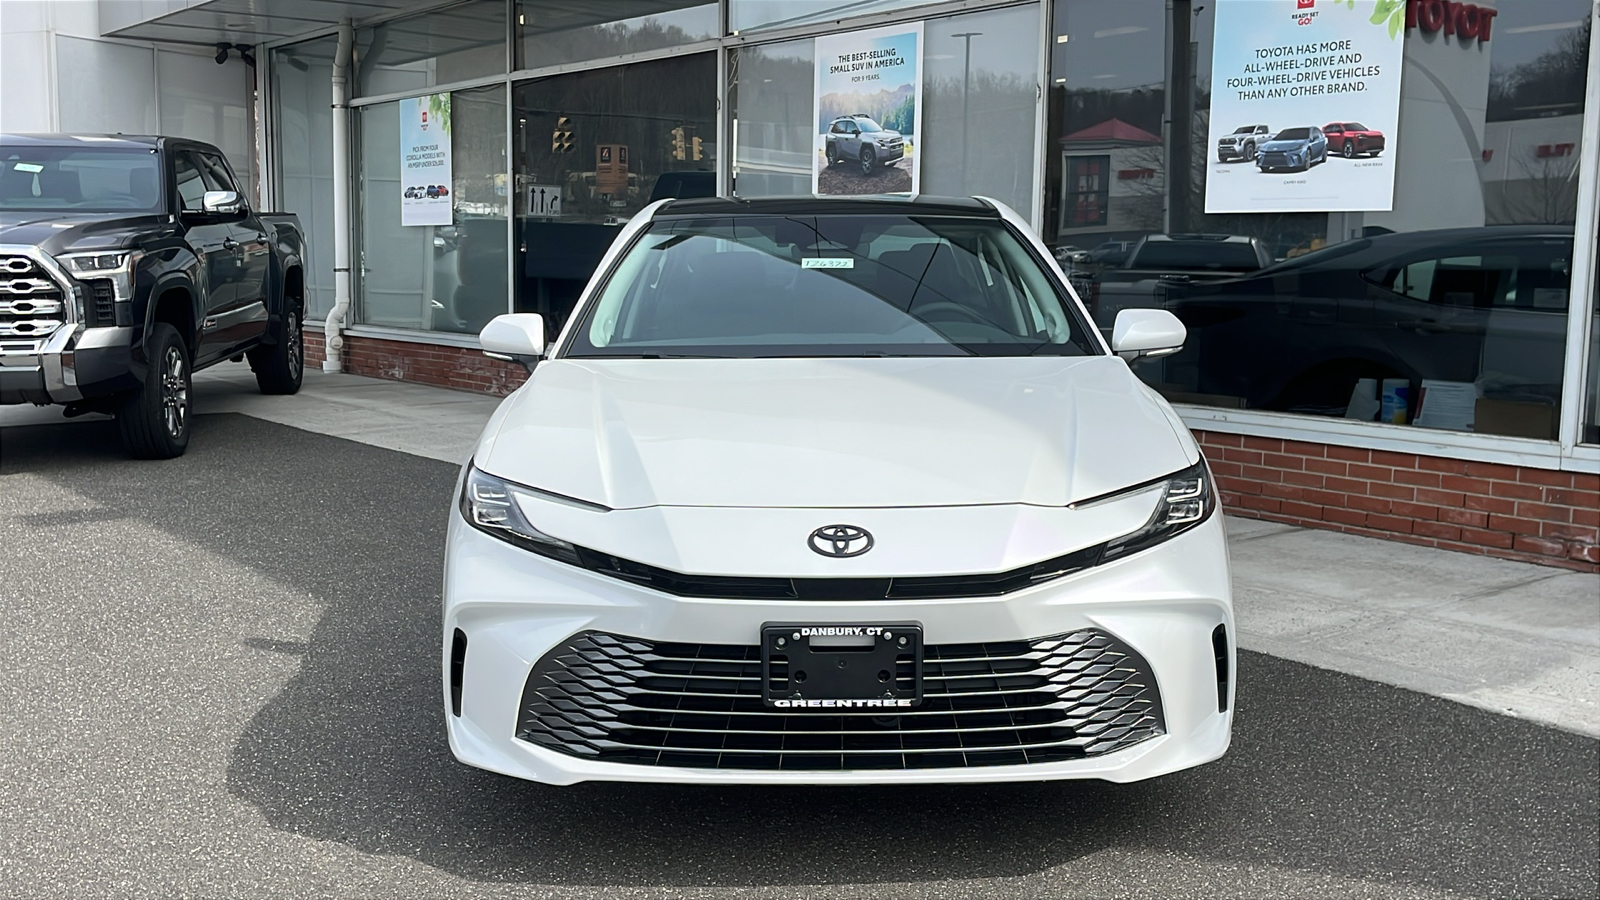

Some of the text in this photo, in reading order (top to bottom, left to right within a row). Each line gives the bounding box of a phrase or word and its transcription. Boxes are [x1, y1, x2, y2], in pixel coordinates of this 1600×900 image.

[1298, 17, 1312, 26] GO!
[838, 48, 896, 64] THE BEST-SELLING
[1255, 40, 1351, 59] TOYOTA HAS MORE
[830, 57, 905, 74] SMALL SUV IN AMERICA
[1244, 53, 1362, 73] ALL-WHEEL-DRIVE AND
[1227, 66, 1380, 88] FOUR-WHEEL-DRIVE VEHICLES
[1238, 81, 1368, 101] THAN ANY OTHER BRAND.
[406, 154, 422, 162] COROLLA
[422, 152, 436, 160] MODELS
[801, 627, 884, 637] DANBURY, CT
[774, 699, 912, 708] GREENTREE
